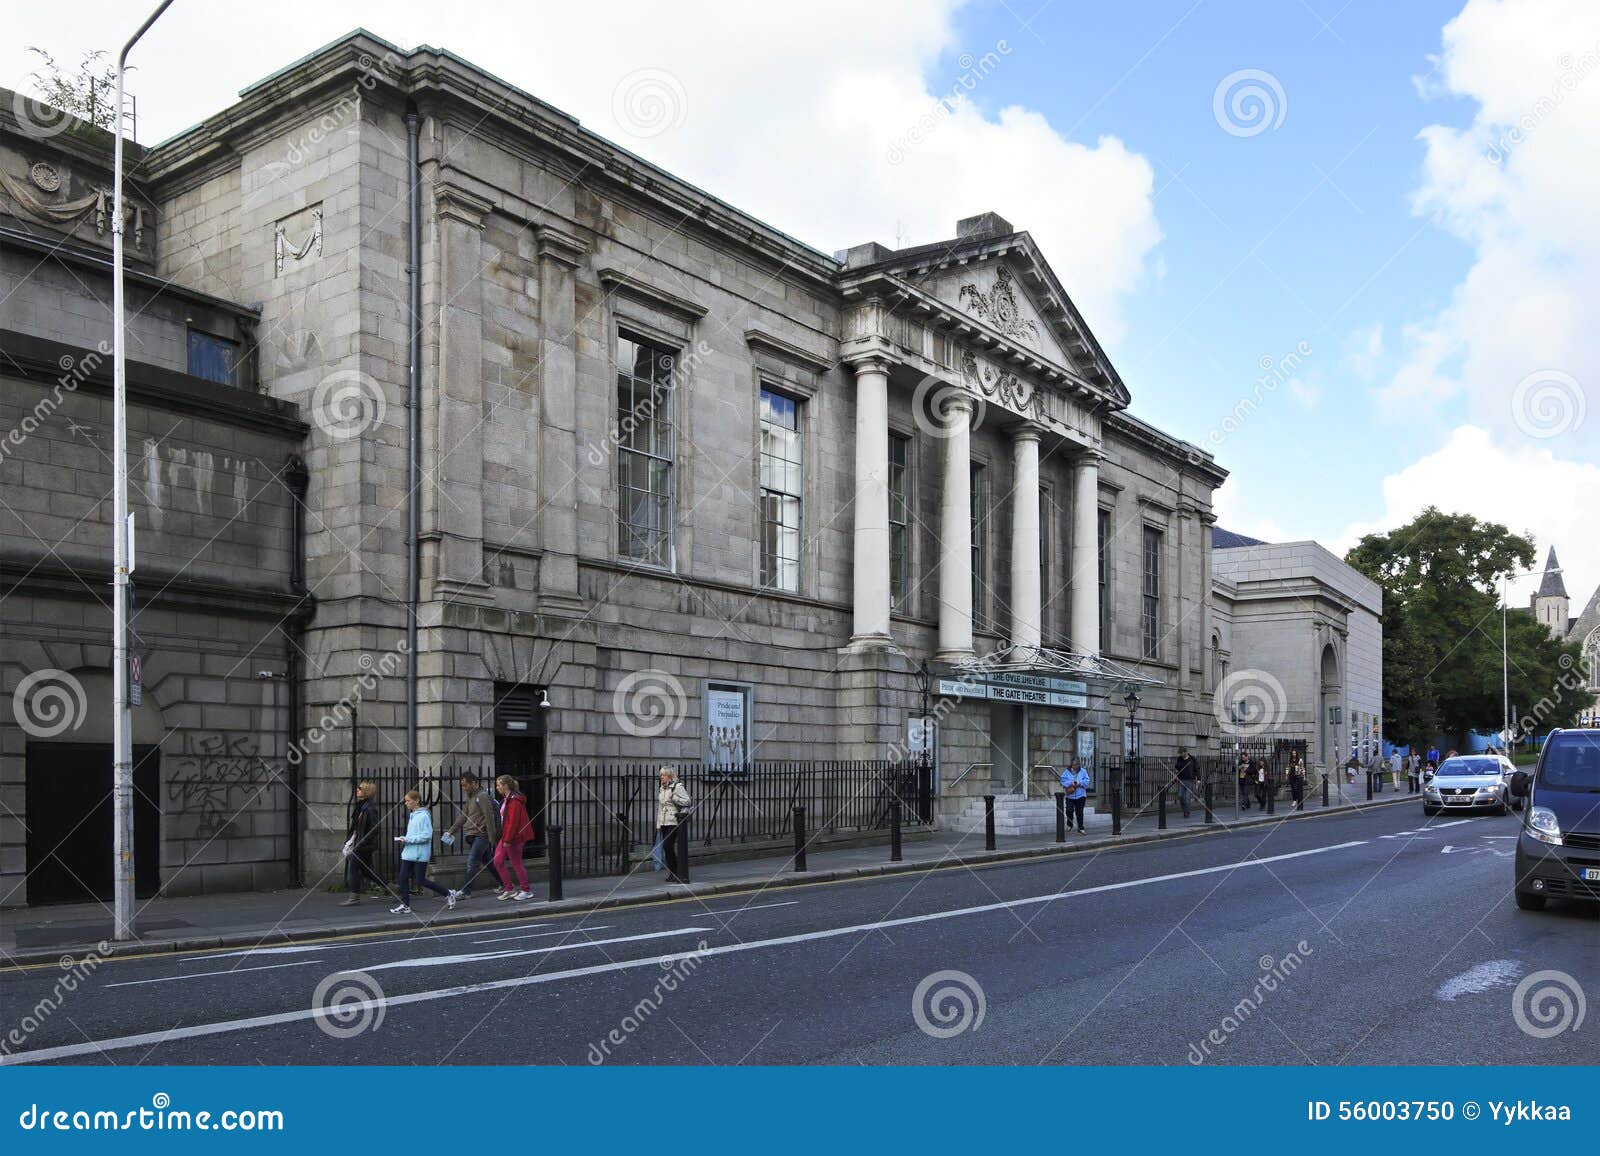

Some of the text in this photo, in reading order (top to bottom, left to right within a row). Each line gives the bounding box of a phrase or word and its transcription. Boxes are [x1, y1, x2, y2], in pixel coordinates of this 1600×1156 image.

[993, 687, 1004, 697] THE
[1005, 689, 1021, 699] GATE
[1022, 691, 1047, 702] THEATRE
[1588, 870, 1600, 880] 07
